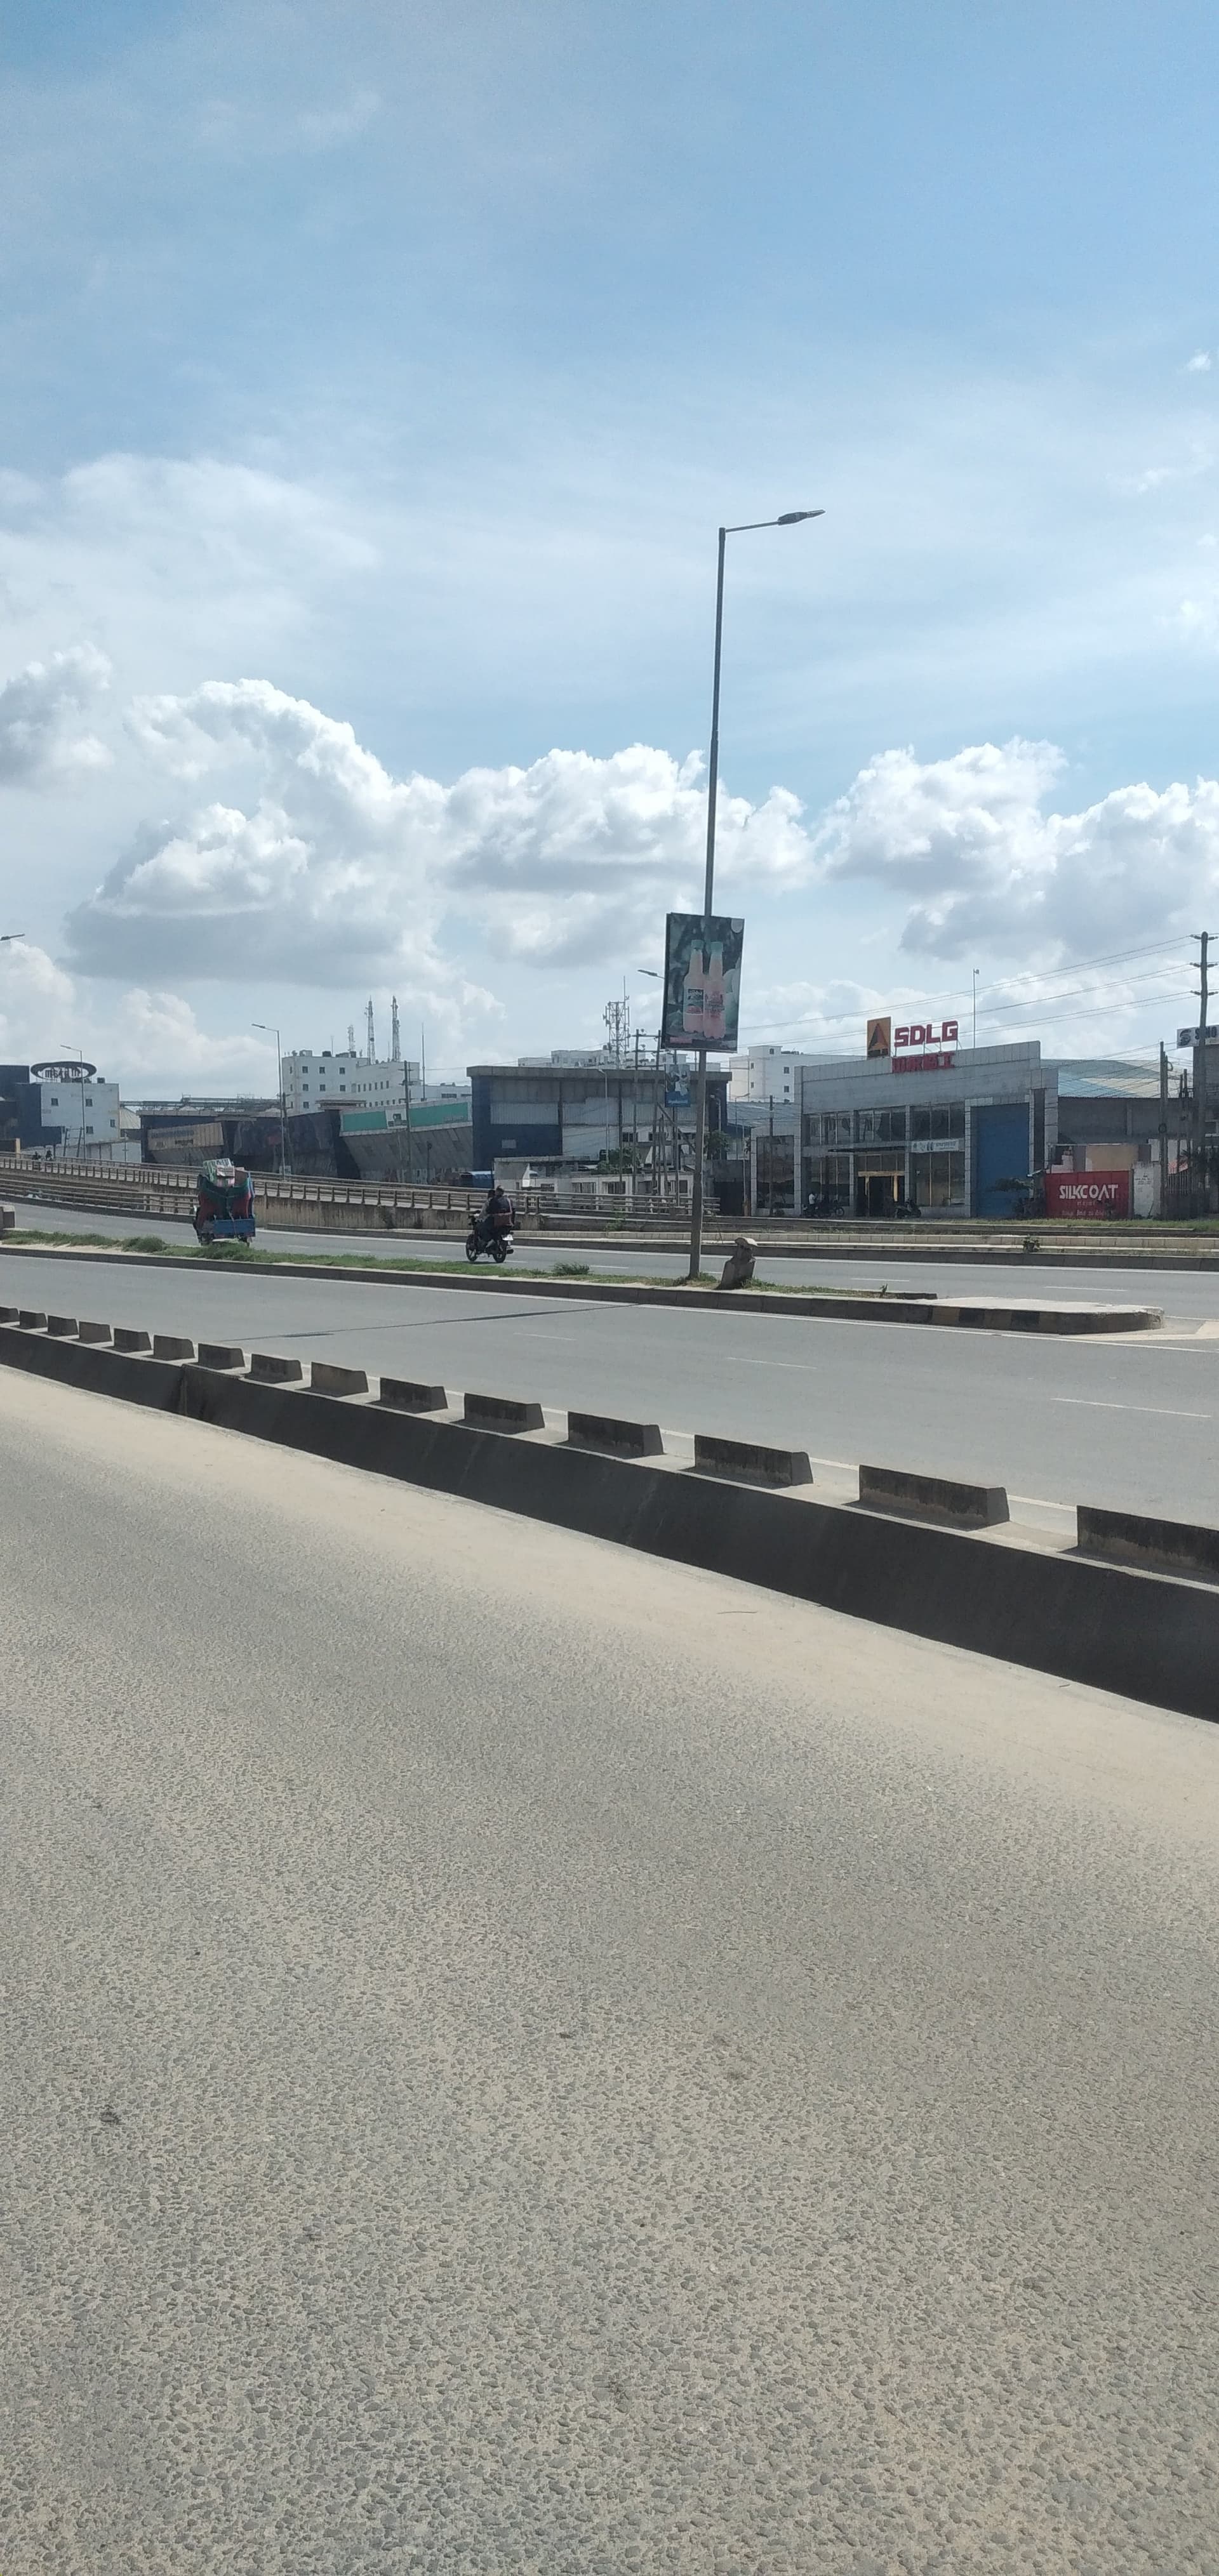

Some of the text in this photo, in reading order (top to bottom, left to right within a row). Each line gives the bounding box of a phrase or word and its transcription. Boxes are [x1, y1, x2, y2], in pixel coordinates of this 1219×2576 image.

[894, 1020, 958, 1047] SDLG
[1195, 1026, 1217, 1040] SNO
[1059, 1184, 1119, 1201] SILKCOAT
